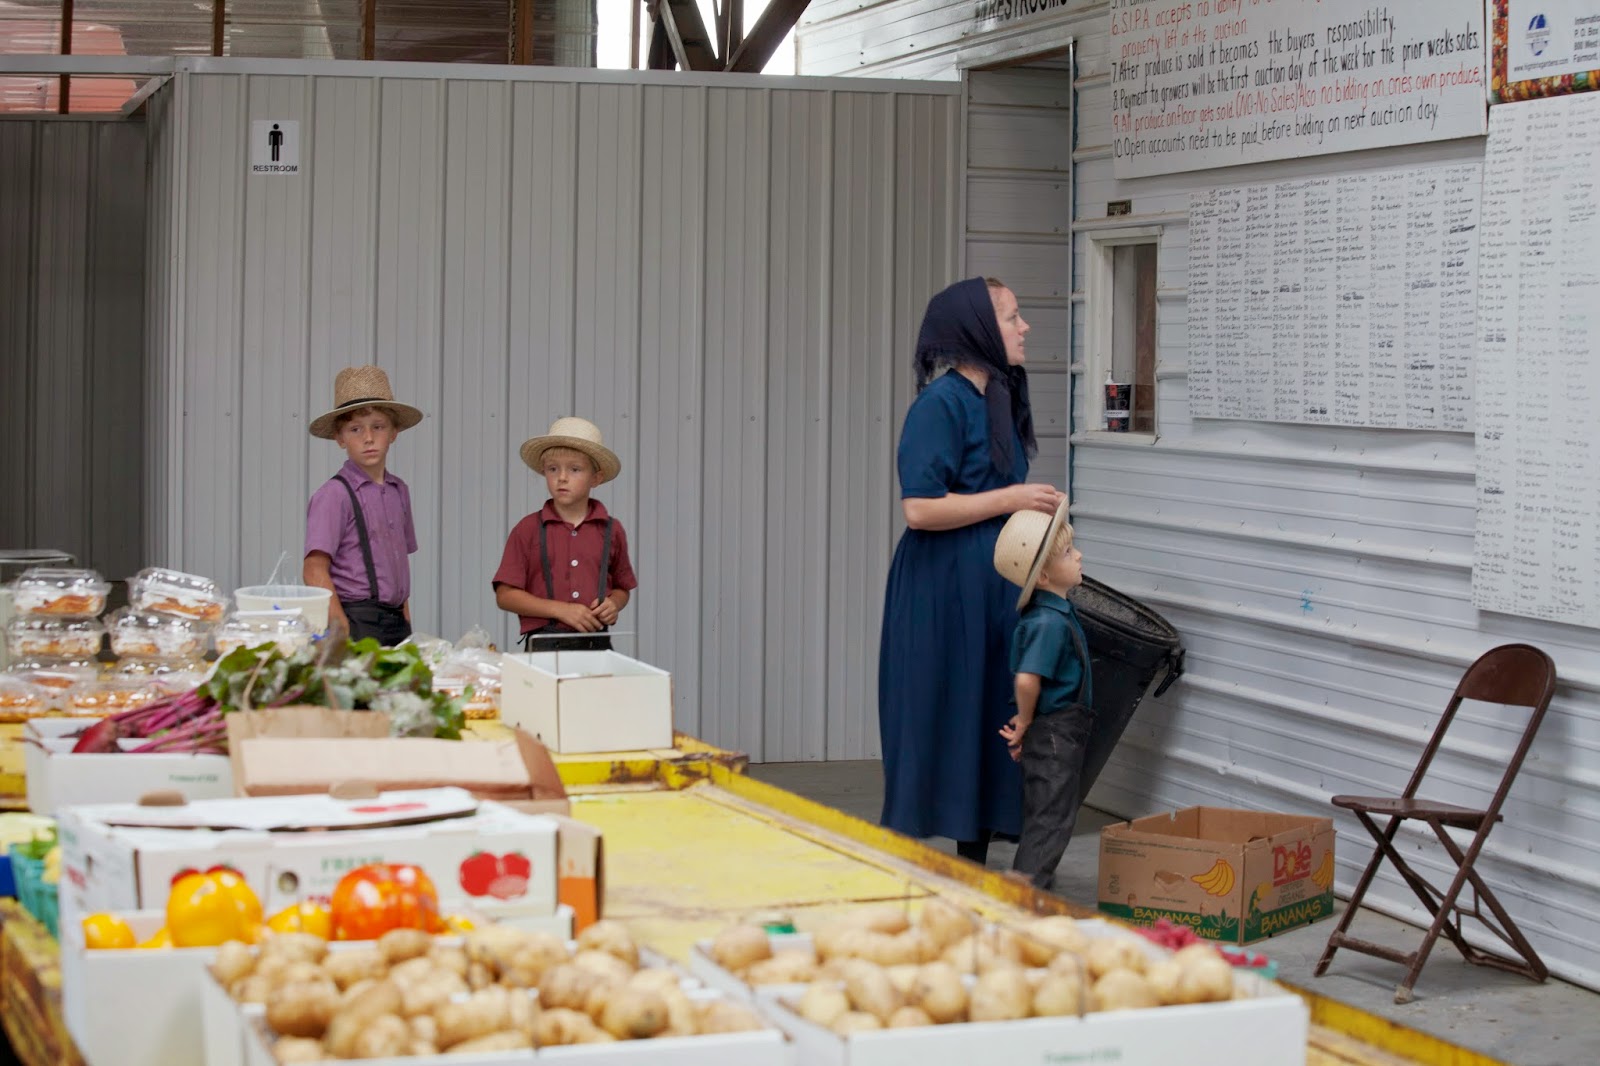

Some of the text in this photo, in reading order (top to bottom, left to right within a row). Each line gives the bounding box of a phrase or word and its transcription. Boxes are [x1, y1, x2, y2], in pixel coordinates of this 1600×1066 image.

[1156, 3, 1191, 30] accepts
[1198, 1, 1209, 17] no
[1121, 33, 1160, 62] property
[1164, 28, 1177, 49] left
[1193, 24, 1206, 43] the
[1214, 19, 1247, 40] auction
[1145, 55, 1172, 91] produce
[1176, 51, 1182, 71] is
[1188, 45, 1204, 69] sold
[1210, 42, 1216, 65] it
[1220, 40, 1258, 63] becomes
[1268, 31, 1282, 54] the
[1287, 27, 1315, 61] buyers
[1327, 7, 1396, 52] responsibility.
[1150, 83, 1158, 103] to
[1161, 82, 1189, 112] growers
[1192, 73, 1205, 96] will
[1208, 72, 1215, 94] be
[1217, 69, 1229, 92] the
[1230, 65, 1248, 90] first
[1255, 58, 1285, 86] auction
[1288, 55, 1304, 90] day
[1308, 49, 1321, 78] of
[1323, 48, 1337, 75] the
[1341, 44, 1360, 71] week
[1363, 41, 1375, 68] for
[1381, 38, 1394, 64] the
[1402, 38, 1424, 73] prior
[1427, 28, 1453, 57] weeks
[1456, 21, 1479, 51] sales.
[1135, 109, 1164, 140] produce
[1200, 105, 1214, 132] gets
[1321, 86, 1333, 104] no
[1335, 76, 1369, 112] bidding
[1372, 79, 1386, 98] on
[1388, 76, 1413, 95] ones
[1416, 73, 1437, 90] own
[1149, 131, 1185, 154] accounts
[1189, 128, 1210, 150] need
[1212, 128, 1222, 147] to
[1226, 125, 1237, 146] be
[1262, 119, 1291, 141] before
[1295, 113, 1323, 144] bidding
[1327, 117, 1339, 133] on
[1344, 106, 1366, 130] next
[1371, 103, 1412, 126] auction
[1417, 95, 1438, 131] day
[253, 164, 298, 172] RESTROOM
[1273, 839, 1312, 880] Dole
[1133, 907, 1203, 925] BANANAS
[1261, 900, 1322, 934] BANANAS
